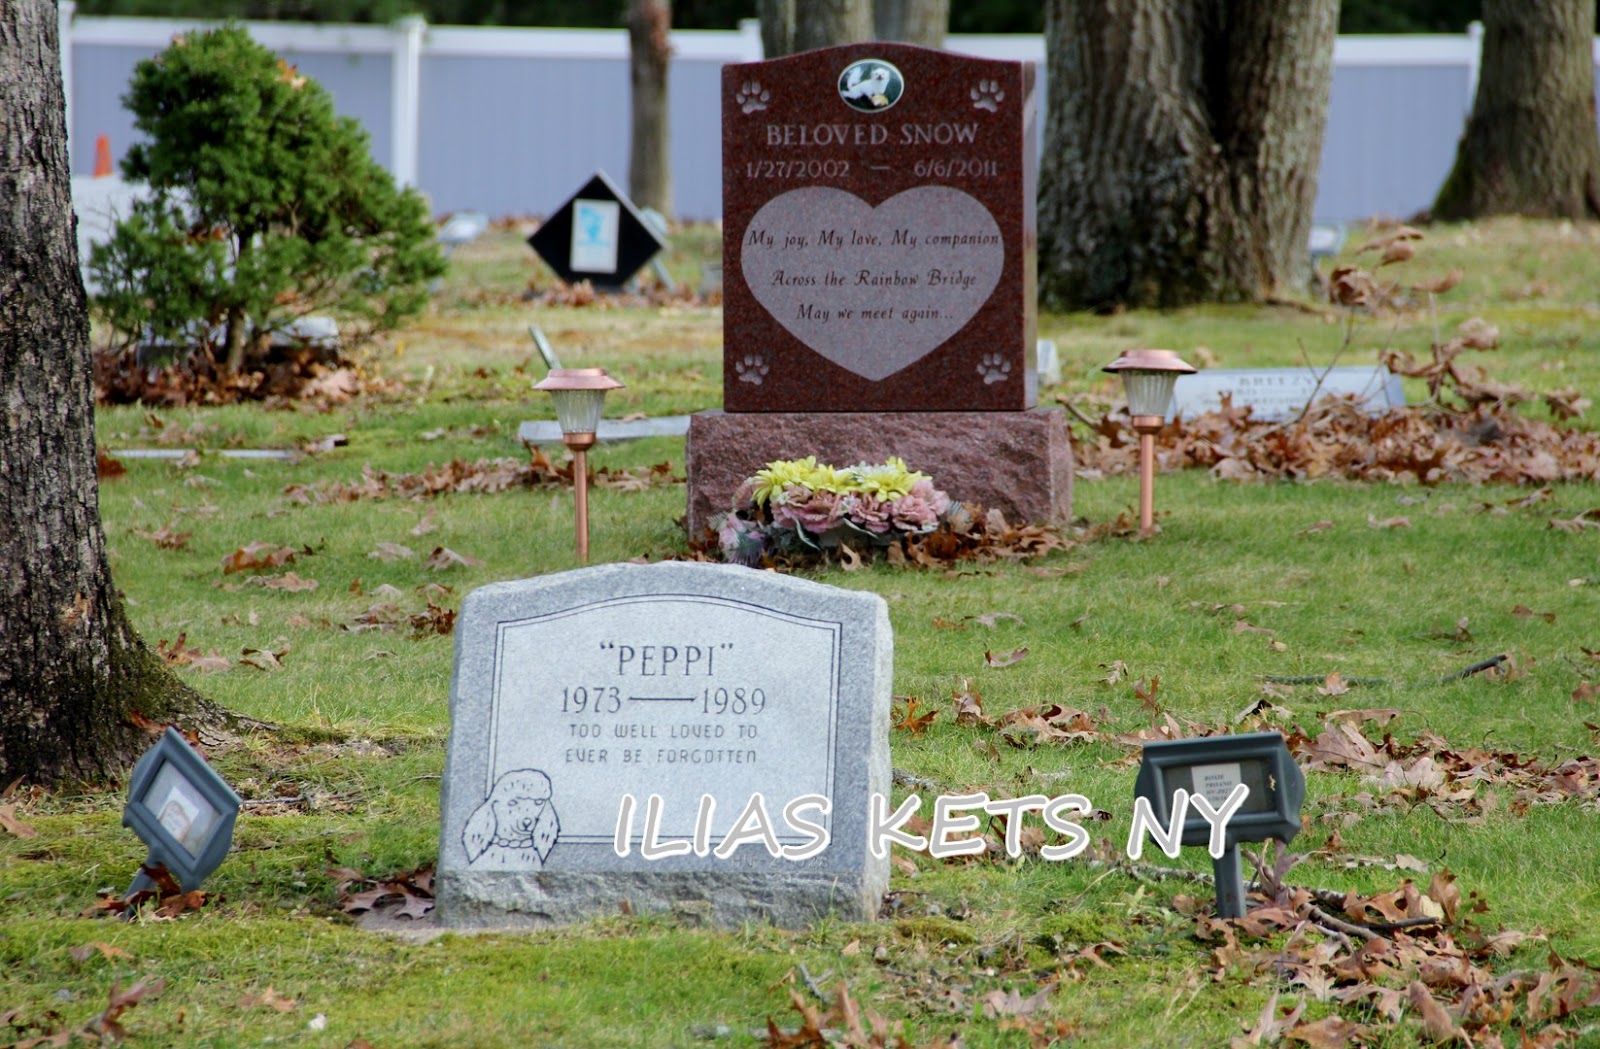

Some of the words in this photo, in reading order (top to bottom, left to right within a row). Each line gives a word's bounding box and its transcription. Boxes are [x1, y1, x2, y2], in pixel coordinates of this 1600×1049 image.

[766, 123, 889, 146] BELOVED
[900, 123, 979, 146] SNOW
[746, 159, 850, 179] 1/27/2002
[913, 159, 998, 178] 6/6/2011
[748, 230, 774, 249] My
[784, 230, 809, 250] joy,
[817, 230, 844, 249] My
[851, 230, 882, 246] love,
[890, 229, 917, 249] My
[925, 232, 999, 250] companion
[771, 269, 816, 287] Across
[825, 270, 845, 286] the
[854, 269, 919, 286] Rainbow
[927, 269, 977, 291] Bridge
[796, 304, 830, 323] May
[837, 307, 853, 319] we
[861, 306, 893, 319] meet
[561, 686, 622, 714] 1973
[701, 687, 767, 715] 1989
[569, 723, 602, 739] TOO
[614, 723, 658, 739] WELL
[670, 724, 725, 739] LOVED
[738, 724, 758, 739] TO
[565, 748, 608, 763] EVER
[623, 749, 643, 764] BE
[657, 749, 757, 764] FORGOTTEN
